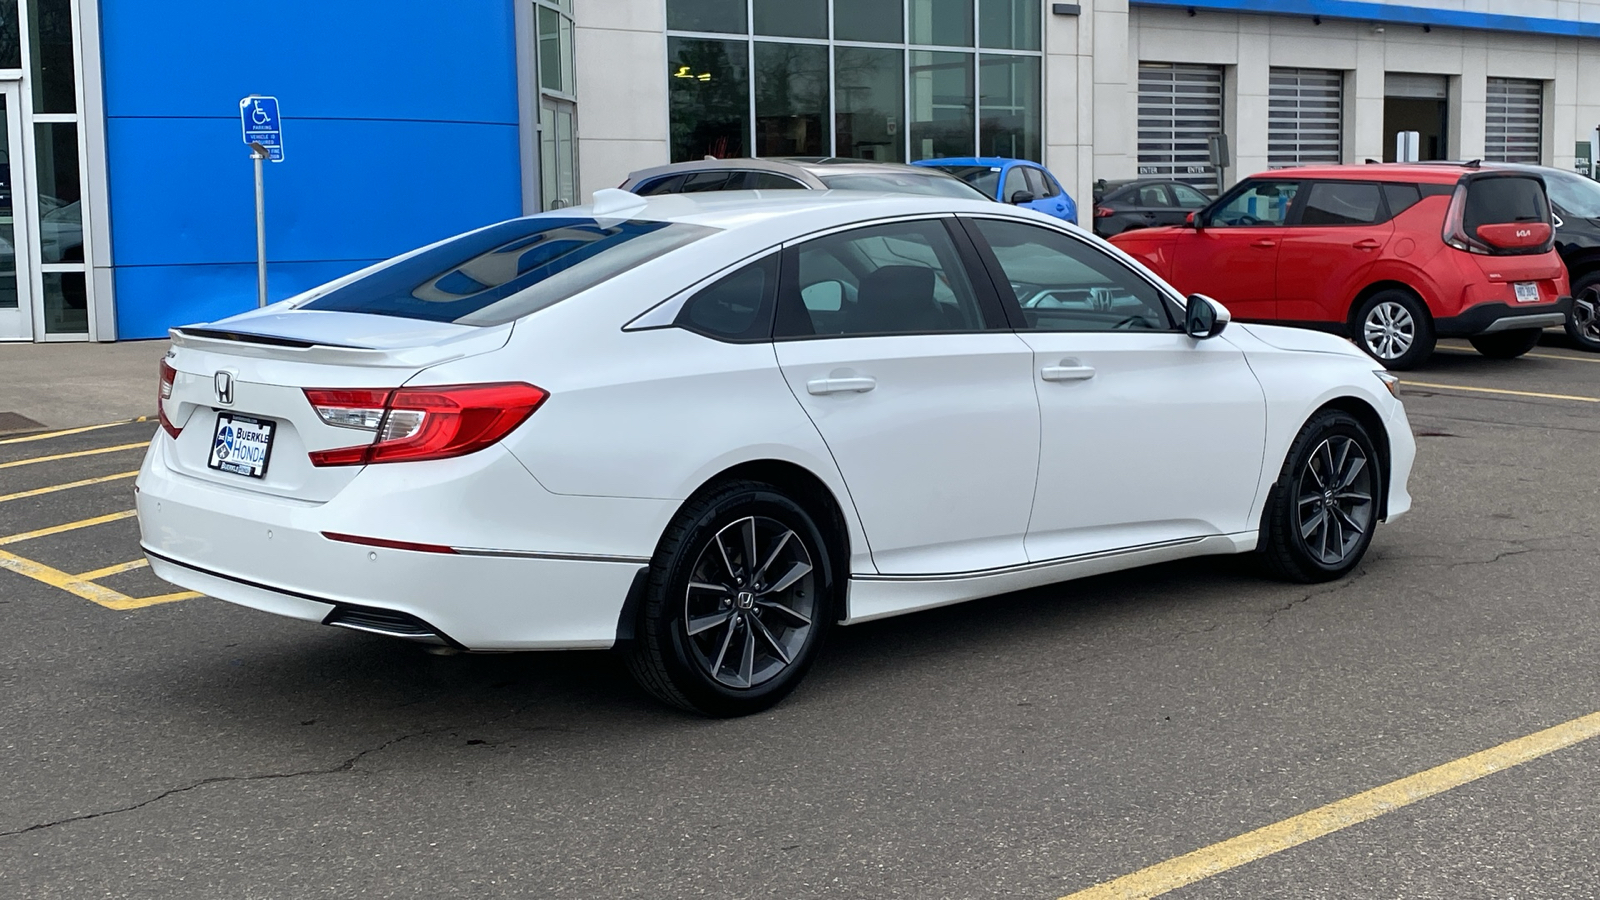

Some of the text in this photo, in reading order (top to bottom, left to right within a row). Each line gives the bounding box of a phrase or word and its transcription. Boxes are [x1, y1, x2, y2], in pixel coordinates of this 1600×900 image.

[1575, 157, 1589, 165] ETAIL
[1140, 166, 1158, 174] ENTER
[1187, 166, 1205, 174] ENTER
[236, 428, 270, 444] BUERKLE
[232, 440, 265, 463] HONDA
